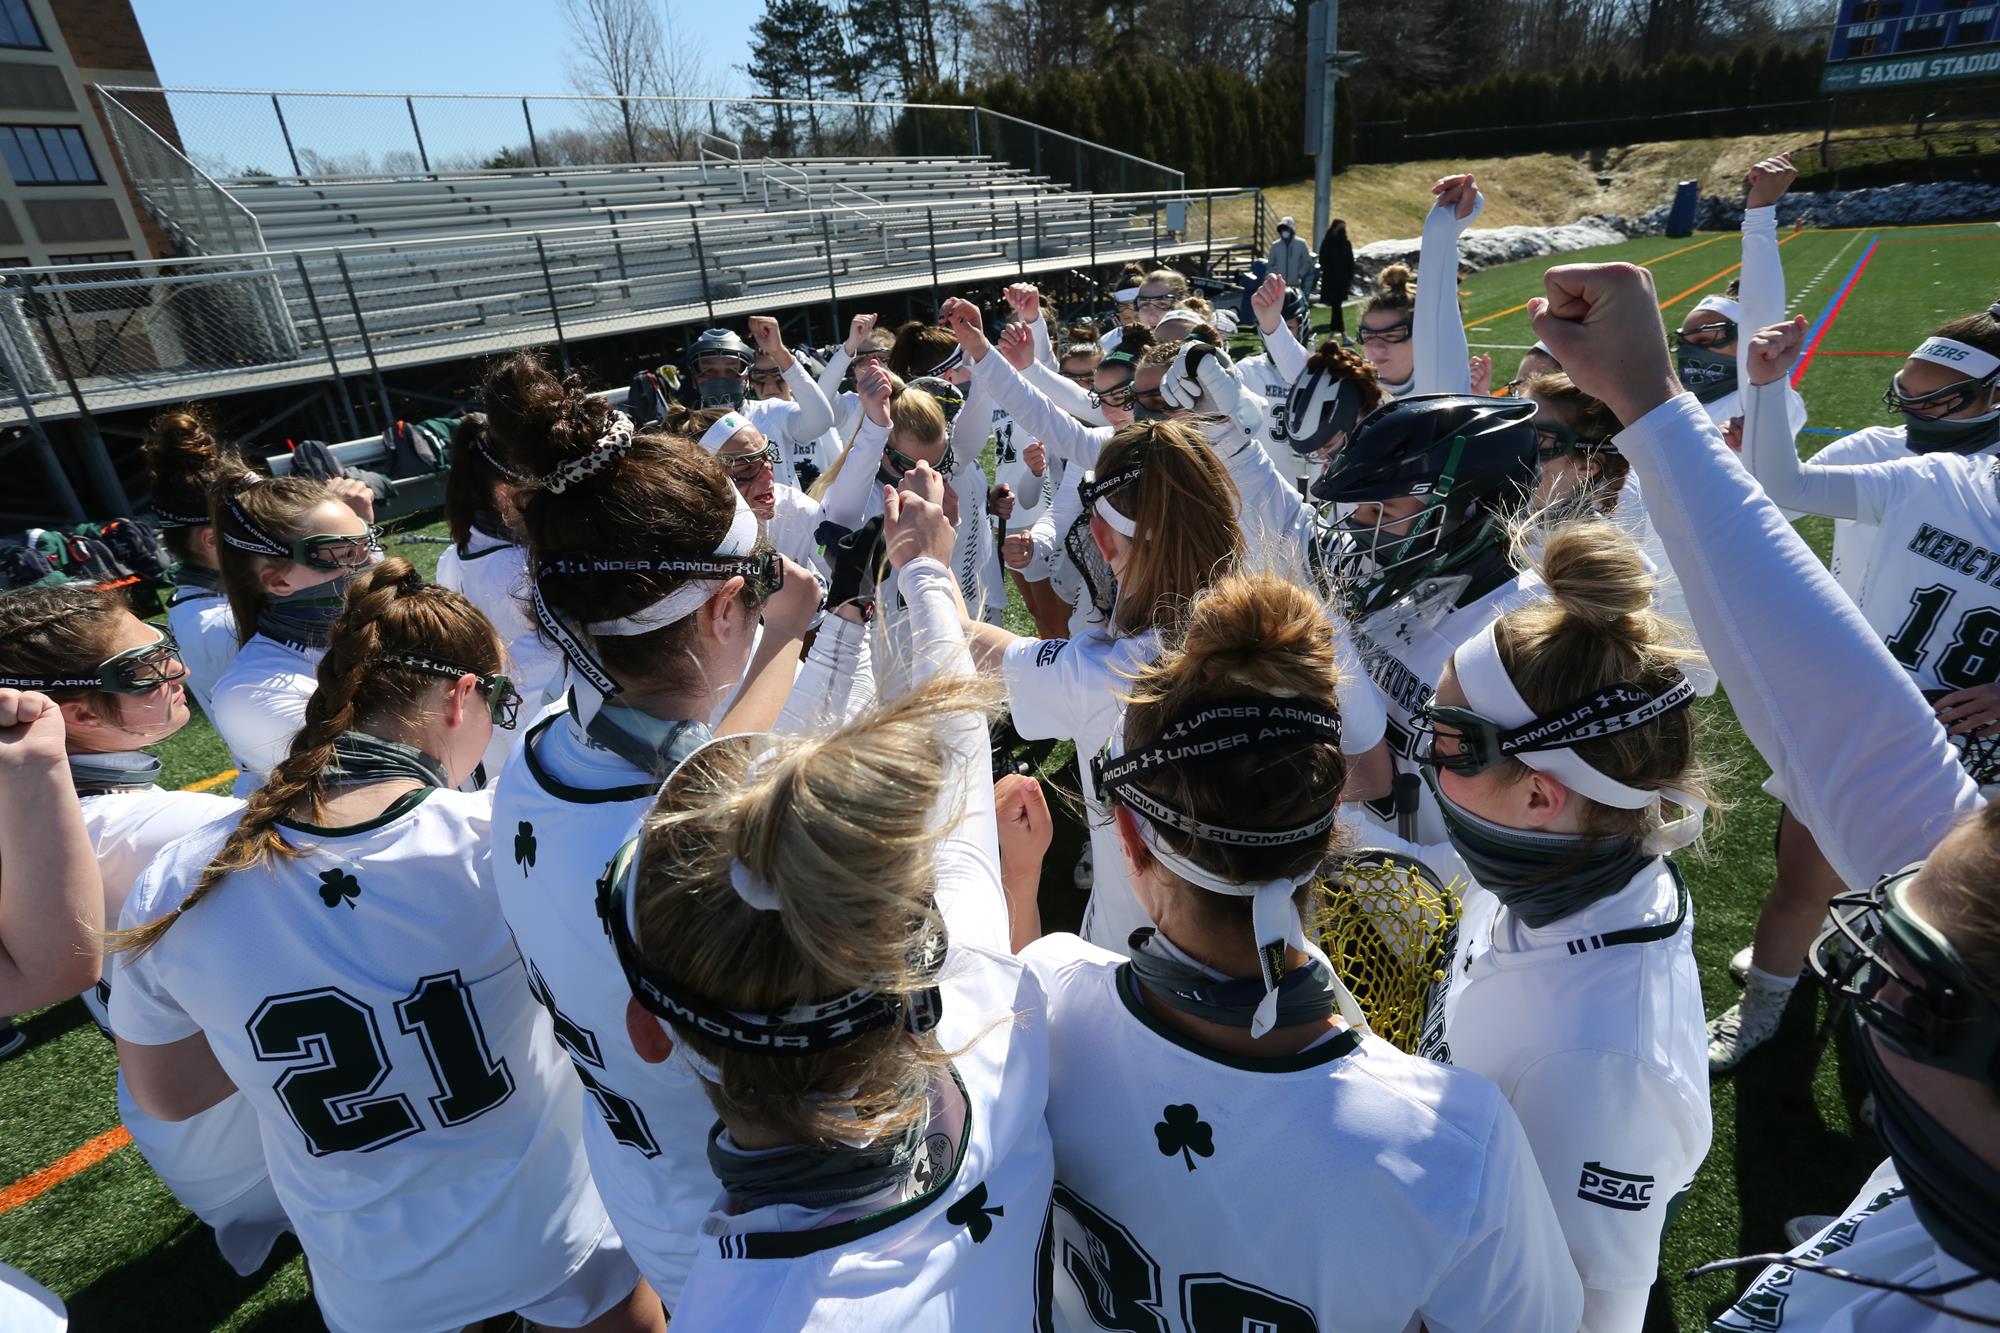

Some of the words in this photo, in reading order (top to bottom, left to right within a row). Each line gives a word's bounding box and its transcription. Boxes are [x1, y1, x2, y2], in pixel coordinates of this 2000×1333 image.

[1860, 61, 1925, 84] SAXON
[1928, 53, 2000, 77] STADIU
[1916, 343, 1970, 361] AKERS
[1265, 384, 1294, 399] MERC
[1094, 476, 1121, 493] UNDER
[244, 522, 290, 555] ARMOUR
[577, 561, 650, 573] UNDER
[656, 560, 732, 574] ARMOUR
[1884, 583, 2000, 690] 18
[1188, 706, 1261, 729] UNDER
[1268, 706, 1337, 731] ARMOUR
[1501, 705, 1595, 751] ARMOUR
[1166, 732, 1250, 761] UNDER
[639, 978, 810, 1049] RMOUR
[245, 969, 517, 1158] 21
[1579, 1169, 1655, 1202] PSAC
